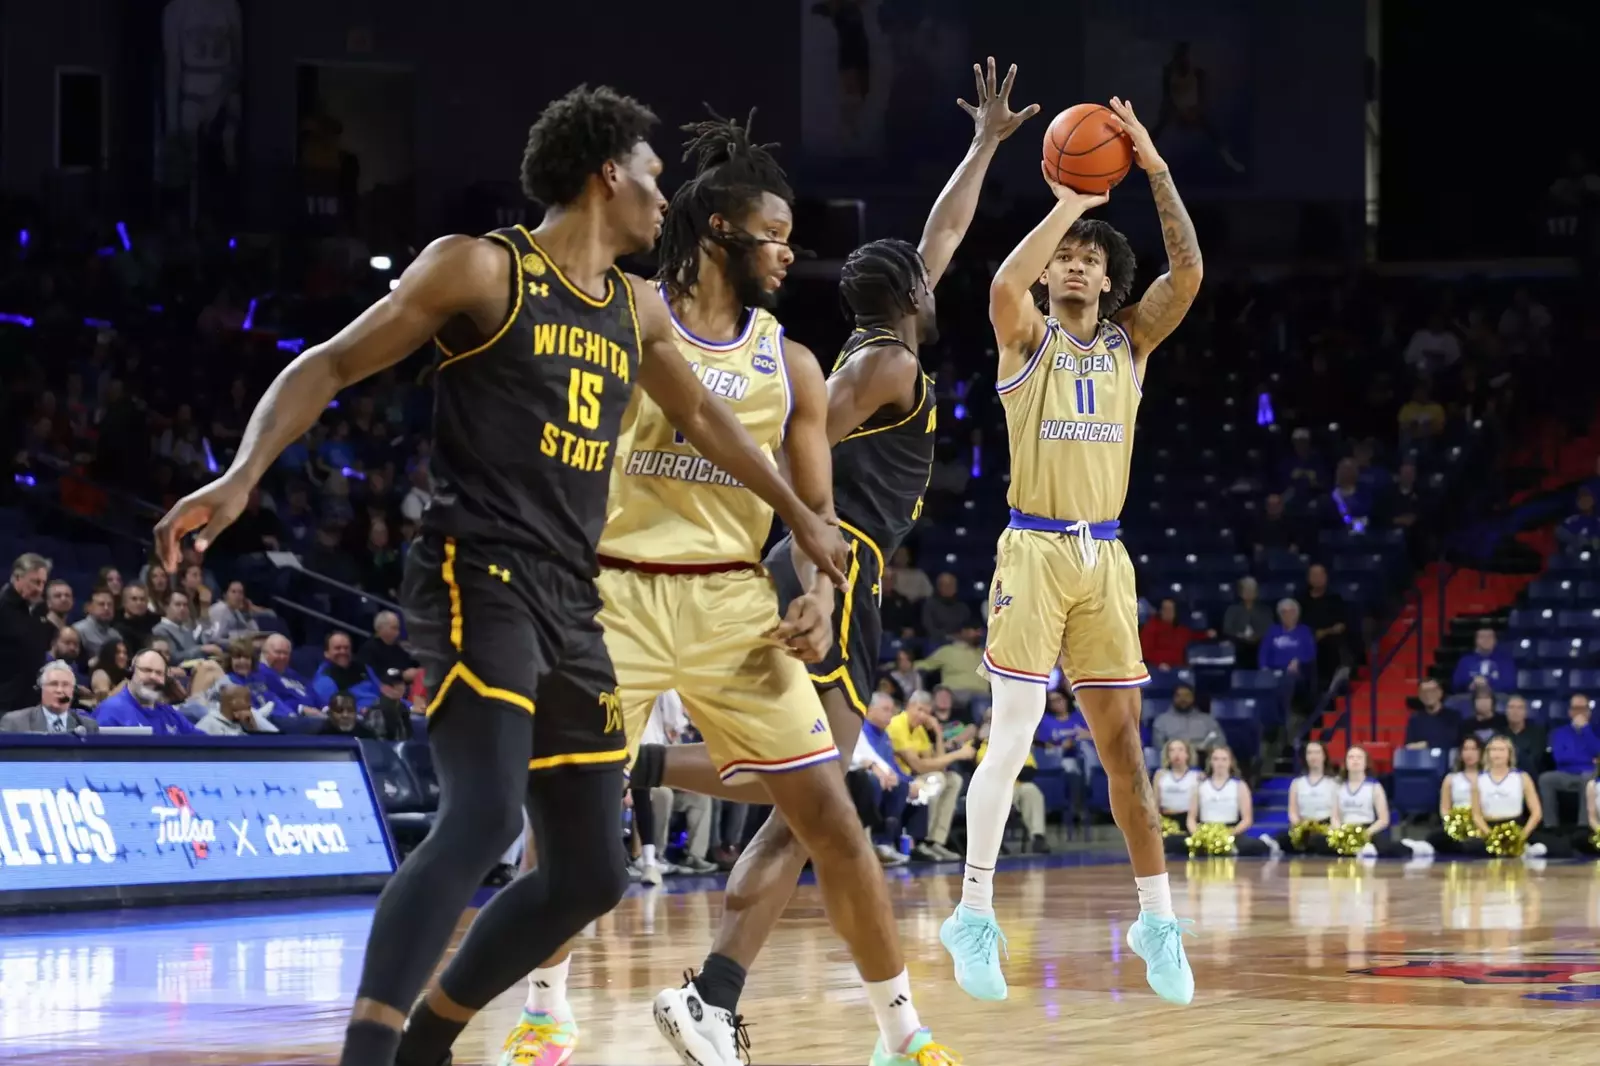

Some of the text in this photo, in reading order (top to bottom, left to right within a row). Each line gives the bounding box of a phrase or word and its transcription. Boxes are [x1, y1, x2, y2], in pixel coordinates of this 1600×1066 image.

[534, 325, 630, 384] WICHITA
[753, 356, 776, 371] DOC
[1055, 353, 1113, 374] GOLDEN
[567, 369, 603, 430] 15
[692, 362, 749, 400] DEN
[1074, 379, 1095, 415] 11
[540, 422, 610, 472] STATE
[1039, 421, 1124, 443] HURRICANE
[626, 451, 744, 487] HURRICA
[151, 805, 216, 844] Tulsa
[265, 814, 349, 855] devon
